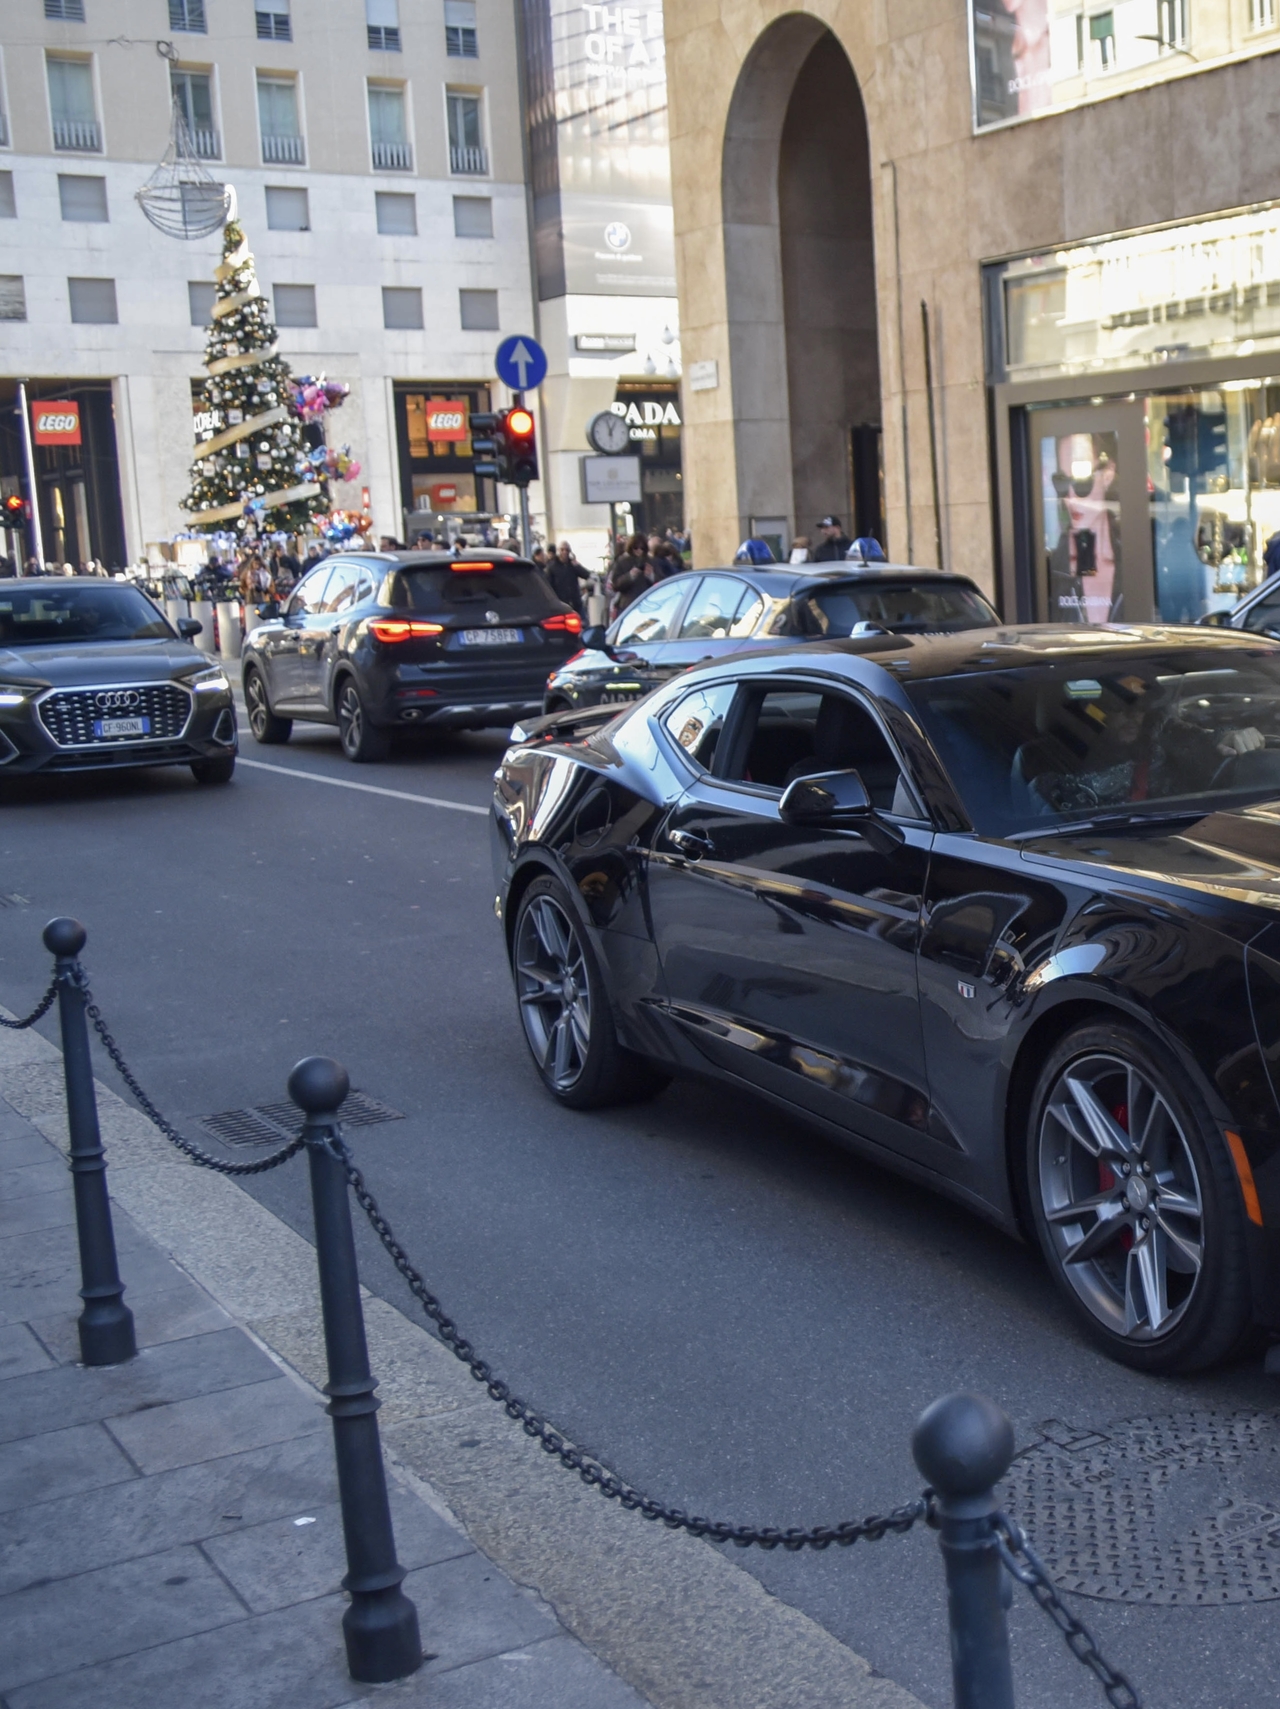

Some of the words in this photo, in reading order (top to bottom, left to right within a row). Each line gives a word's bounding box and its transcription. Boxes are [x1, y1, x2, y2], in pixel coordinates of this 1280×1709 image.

[582, 4, 640, 36] THE
[585, 34, 623, 62] OF
[629, 37, 650, 65] A
[38, 413, 76, 432] LEGO
[431, 413, 462, 428] LEGO
